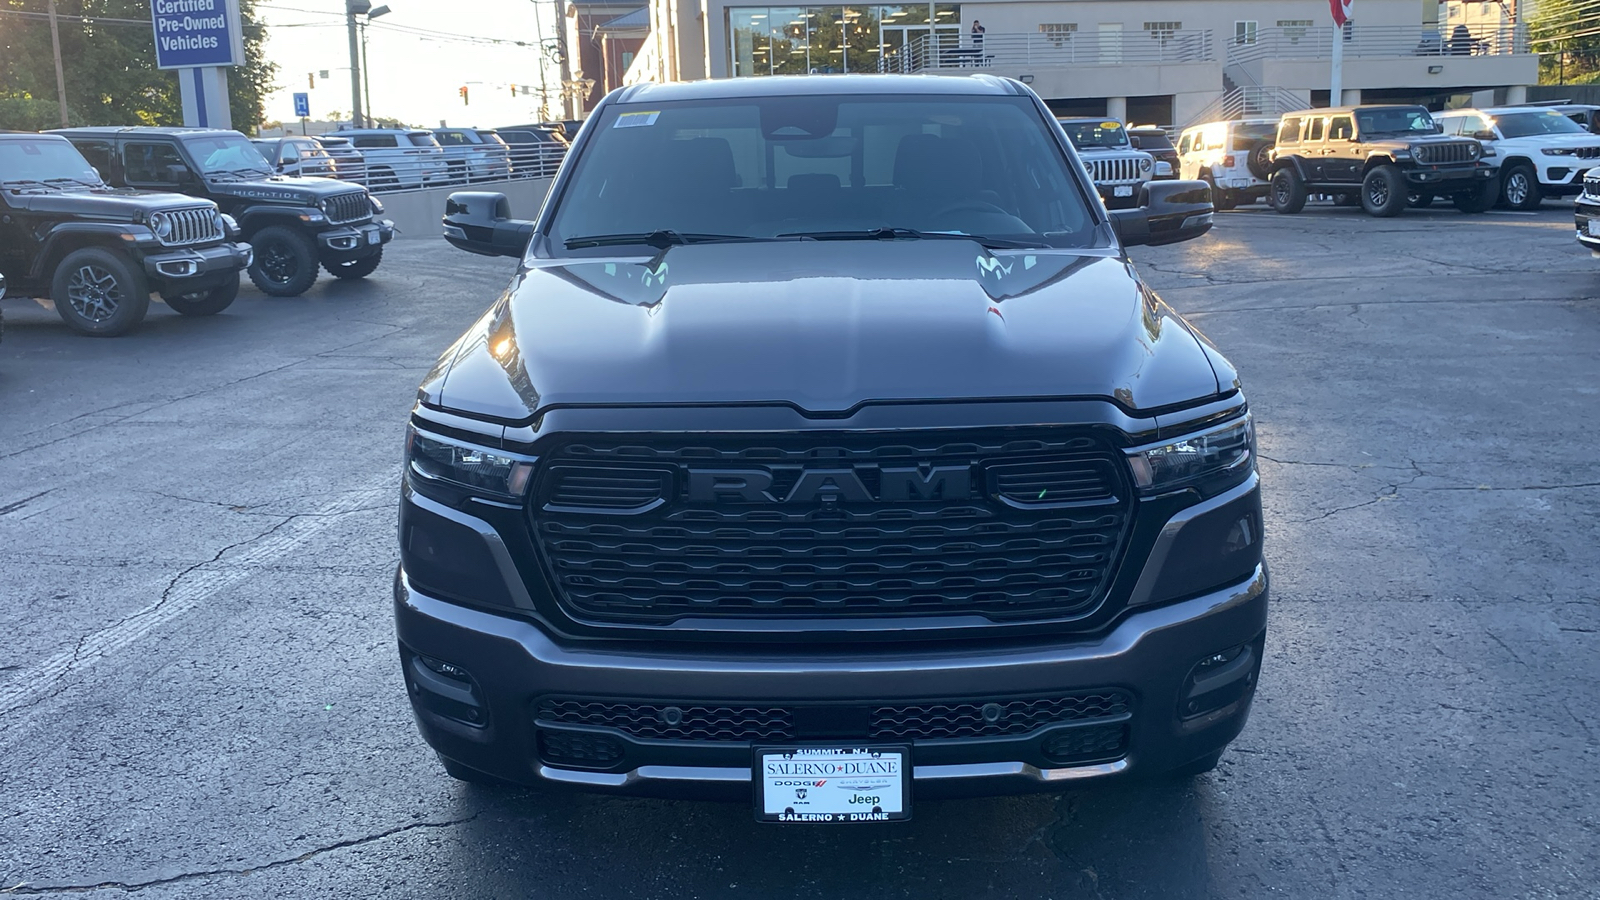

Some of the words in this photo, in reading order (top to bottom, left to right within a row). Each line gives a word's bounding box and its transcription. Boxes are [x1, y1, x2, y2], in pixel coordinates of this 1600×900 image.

[156, 0, 214, 13] Certified
[158, 14, 225, 32] Pre-Owned
[160, 34, 218, 51] Vehicles
[296, 97, 307, 110] H
[687, 465, 971, 502] RAM
[767, 763, 836, 775] SALERNO
[844, 761, 898, 774] DUANE
[848, 793, 881, 805] Jeep
[778, 813, 833, 822] SALERNO
[850, 812, 889, 821] DUANE
